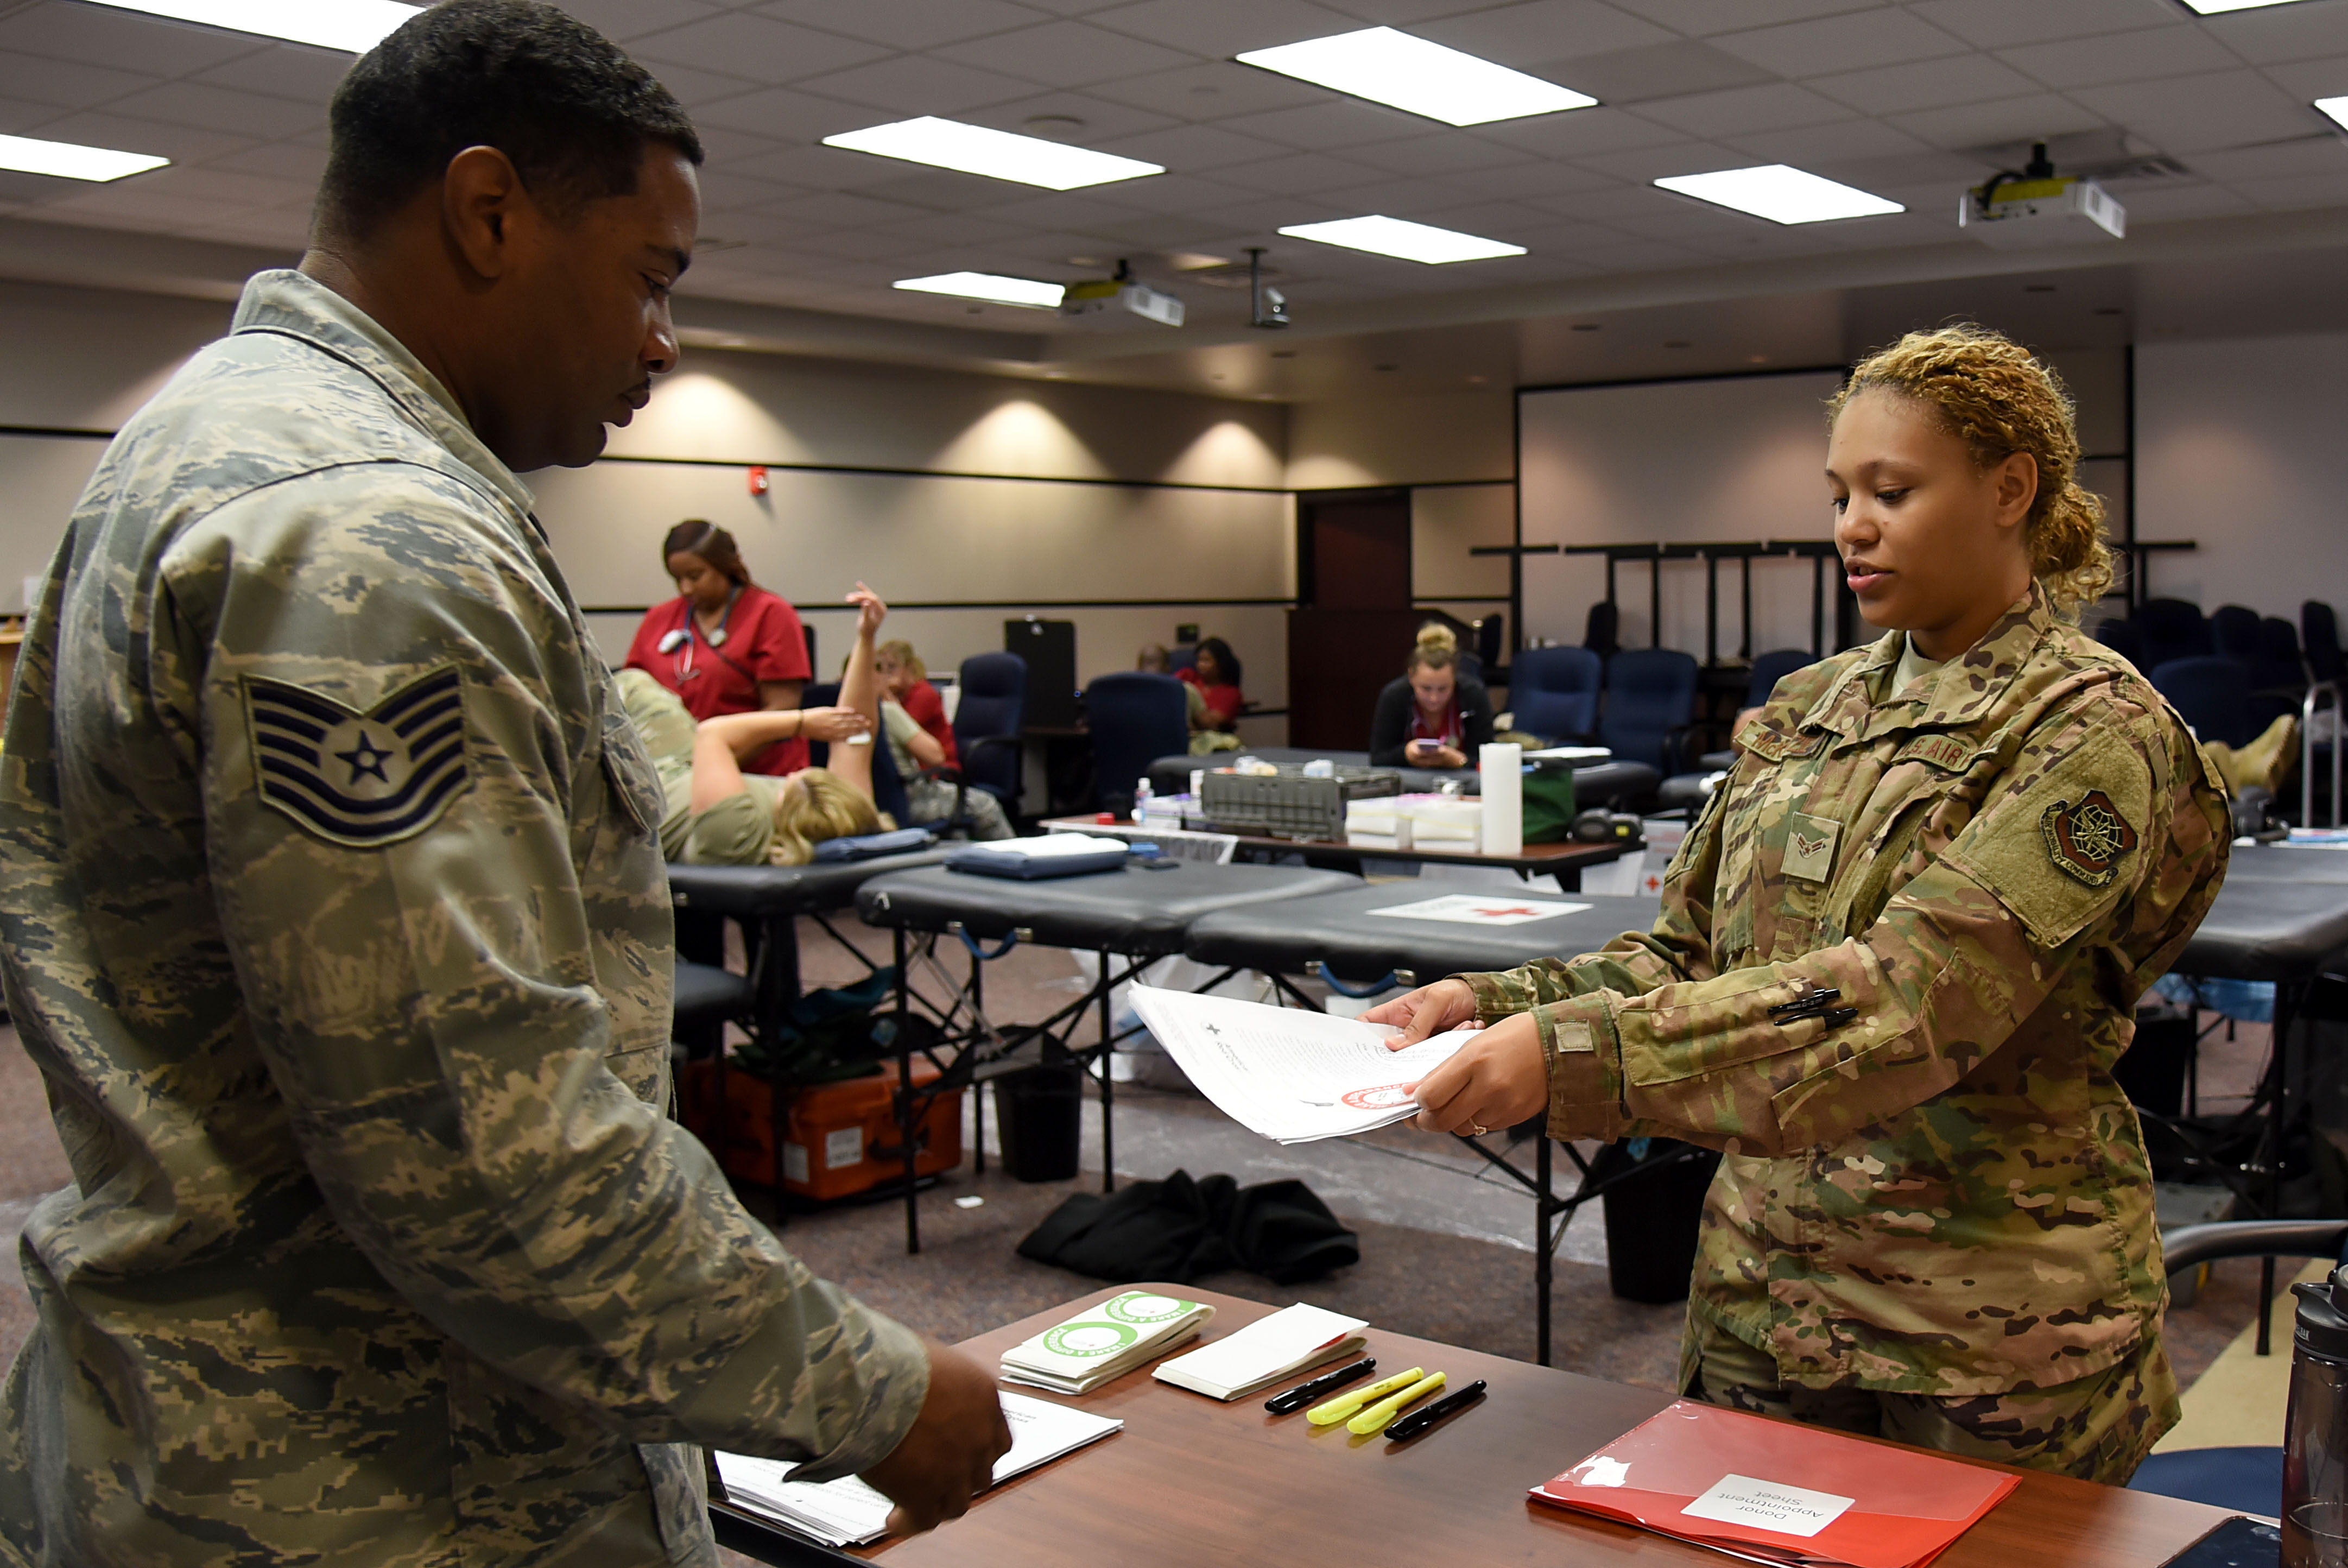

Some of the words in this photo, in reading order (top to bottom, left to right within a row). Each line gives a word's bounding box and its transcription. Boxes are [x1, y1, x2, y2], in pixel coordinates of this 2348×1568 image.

[1925, 739, 1963, 767] AIR
[2044, 815, 2053, 827] AIR
[2046, 830, 2065, 863] MOBILITY
[2066, 862, 2099, 884] COMMAND
[1110, 1298, 1137, 1322] DIFFERENCE
[1150, 1311, 1181, 1322] MAKE
[1048, 1327, 1074, 1355] DIFFERENCE
[1088, 1345, 1121, 1356] MAKE
[1716, 1492, 1824, 1519] Appointment
[1753, 1490, 1803, 1506] Sheet
[1735, 1505, 1787, 1520] Donor
